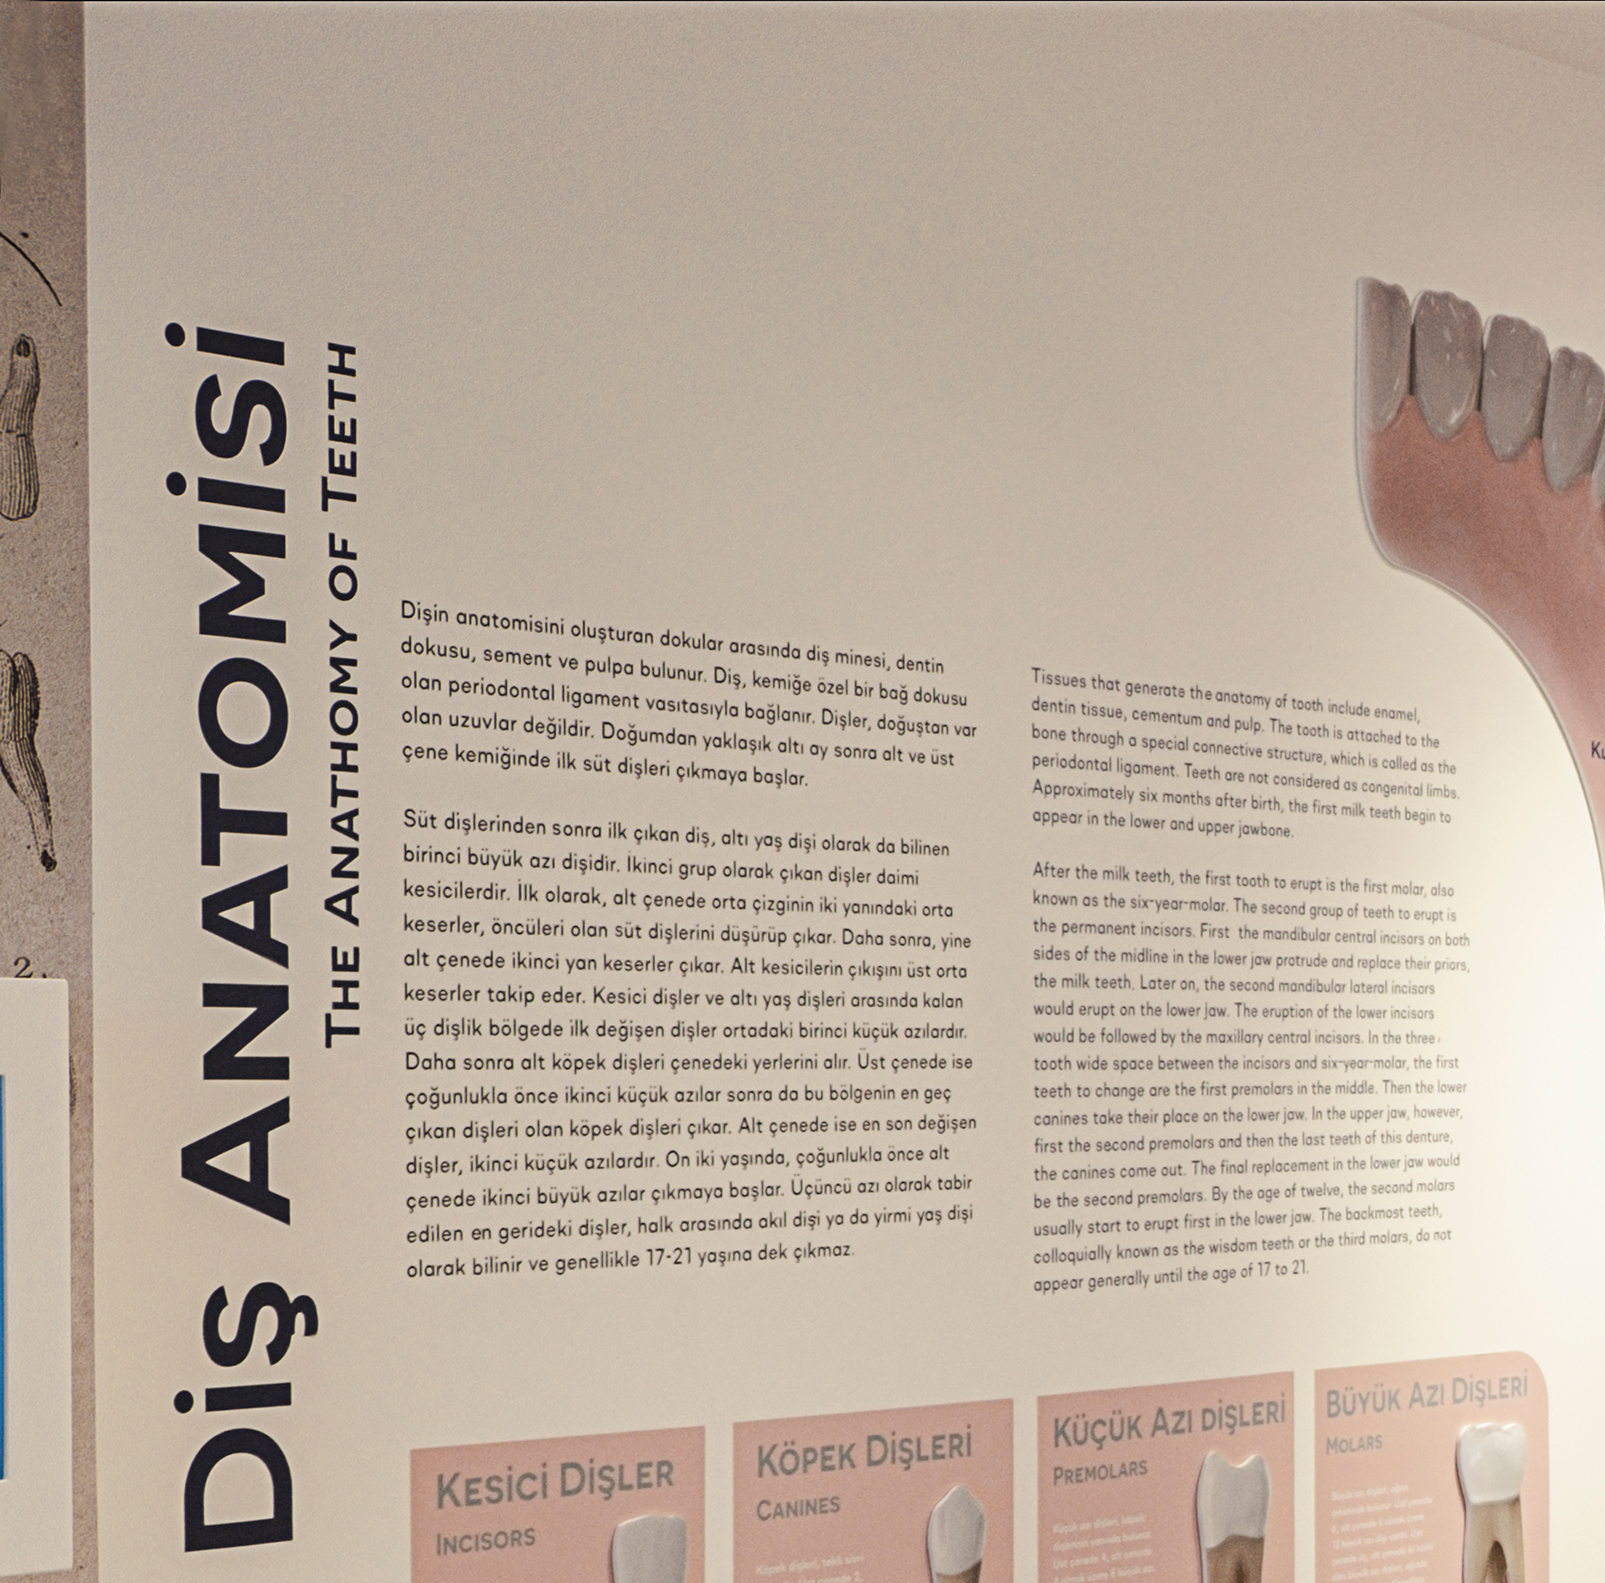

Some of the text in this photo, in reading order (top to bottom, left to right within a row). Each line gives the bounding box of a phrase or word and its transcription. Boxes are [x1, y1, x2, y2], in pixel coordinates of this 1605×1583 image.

[400, 599, 945, 674] Dişin anatomisini oluşturan dokular arasında diş minesi, dentin
[321, 342, 361, 1048] THE ANATHOMY OF TEETH
[400, 634, 968, 707] dokusu, sement ve pulpa bulunur. Diş, kemiğe özel bir bağ dokusu
[1030, 666, 1421, 724] Tissues that generate the anatomy of tooth include enamel,
[400, 670, 978, 737] olan periodontal ligament vasıtasıyla bağlanır. Dişler, doğuştan var
[164, 322, 291, 1226] ANATOMİSİ
[406, 1241, 855, 1278] olarak bilinir ve genellikle 17-21 yaşına dek çıkmaz.
[1033, 1258, 1311, 1295] appear generally until the age of 17 to 21.
[1325, 1368, 1528, 1419] BÜYÜK AZI DİŞLERİ
[1053, 1392, 1286, 1451] KÜÇÜK AZI DİŞLERİ
[1325, 1433, 1384, 1456] MOLARS
[757, 1423, 972, 1479] KÖPEK DİŞLERİ
[1052, 1459, 1149, 1486] PREMOLARS
[436, 1457, 675, 1510] KESİCİ DİŞLER
[755, 1495, 842, 1522] CANINES
[435, 1526, 537, 1557] INCISORS
